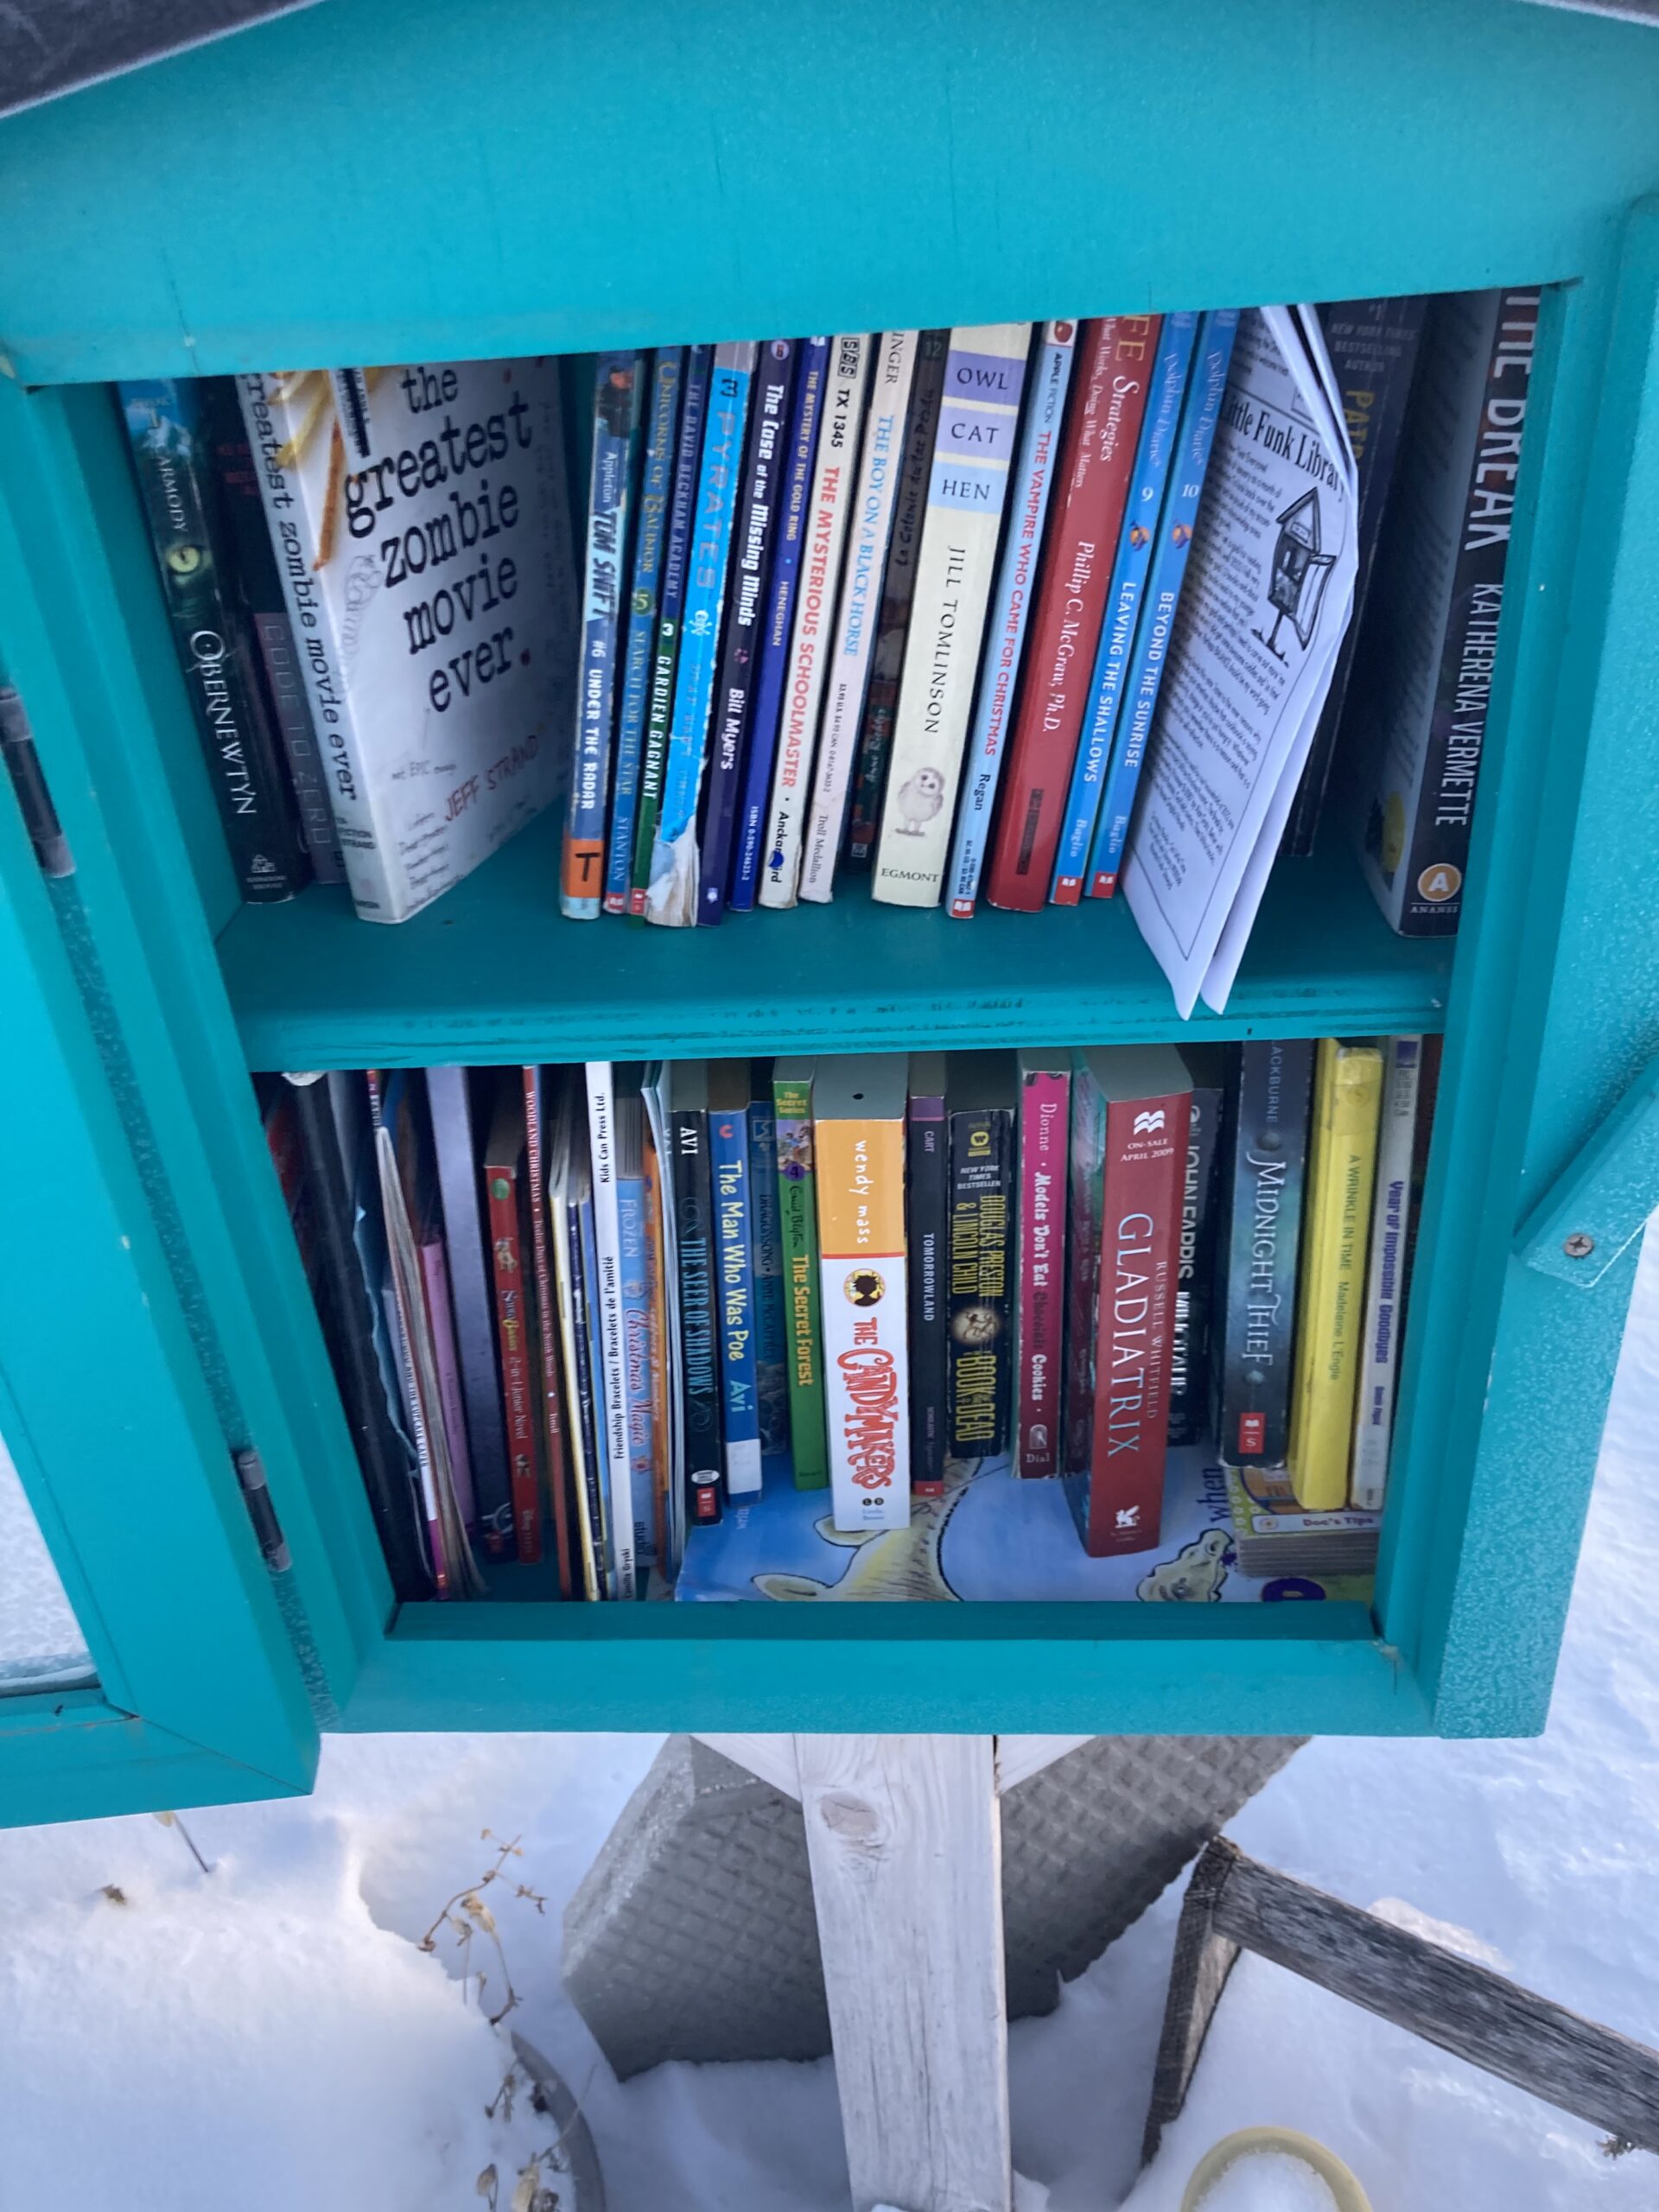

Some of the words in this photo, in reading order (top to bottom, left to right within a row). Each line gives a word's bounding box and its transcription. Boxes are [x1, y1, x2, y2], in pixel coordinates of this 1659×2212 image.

[1331, 323, 1353, 334] NEW
[1333, 340, 1402, 357] BESTSELLING
[807, 371, 819, 390] THE
[957, 367, 1009, 390] OWL
[1050, 353, 1063, 385] APPLE
[1344, 359, 1385, 372] AUTHOR
[400, 366, 459, 414] the
[764, 384, 785, 415] The
[836, 389, 849, 408] TX
[1044, 388, 1058, 423] FICTION
[1086, 385, 1104, 415] Doing
[800, 393, 815, 442] MYSTERY
[831, 415, 847, 448] 1345
[874, 415, 894, 453] THE
[951, 423, 1000, 444] CAT
[1082, 419, 1099, 446] What
[1100, 376, 1140, 462] Strategies
[1254, 409, 1294, 461] Funk
[759, 421, 780, 459] Case
[798, 446, 808, 459] OF
[1035, 430, 1051, 464] THE
[344, 391, 533, 538] greatest
[602, 451, 618, 503] Appleton
[756, 465, 768, 478] of
[794, 463, 807, 481] THE
[821, 467, 840, 504] THE
[869, 457, 889, 493] BOY
[1076, 453, 1091, 488] Matters
[1465, 399, 1527, 551] BREAK
[696, 411, 735, 590] PYRATES
[753, 480, 766, 499] the
[791, 485, 803, 512] GOLD
[864, 496, 880, 524] ON
[943, 480, 991, 501] HEN
[1022, 469, 1045, 539] VAMPIRE
[381, 479, 519, 588] zombie
[594, 511, 618, 551] TOM
[741, 504, 768, 571] Missing
[786, 516, 798, 541] RING
[803, 510, 833, 637] MYSTERIOUS
[853, 543, 874, 600] BLACK
[945, 545, 966, 588] JILL
[1015, 543, 1033, 586] WHO
[1065, 541, 1095, 594] Phillip
[403, 552, 518, 655] movie
[737, 575, 760, 626] Minds
[772, 581, 790, 646] HENEGHAN
[1006, 590, 1023, 633] CAME
[1109, 582, 1136, 657] LEAVING
[842, 601, 867, 658] HORSE
[1147, 592, 1174, 662] BEYOND
[262, 625, 298, 709] CODE
[278, 521, 320, 627] zombie
[305, 638, 340, 723] movie
[329, 734, 358, 801] ever
[924, 600, 958, 734] TOMLINSON
[1000, 639, 1016, 667] FOR
[1453, 584, 1504, 713] KATHERENA
[651, 655, 671, 722] GARDIEN
[1103, 663, 1121, 690] THE
[1140, 667, 1160, 695] THE
[728, 688, 745, 713] Bill
[782, 643, 814, 787] SCHOOLMASTER
[985, 673, 1009, 755] CHRISTMAS
[1042, 693, 1065, 732] Ph.D.
[585, 728, 600, 754] THE
[721, 718, 743, 770] Myers
[1084, 696, 1113, 783] SHALLOWS
[1125, 701, 1151, 768] SUNRISE
[644, 730, 666, 799] GAGNANT
[1435, 721, 1484, 825] VERMETTE
[581, 762, 598, 810] RADAR
[974, 773, 991, 811] Regan
[748, 806, 759, 827] ISBN
[816, 814, 829, 836] Troll
[613, 817, 629, 880] STANTON
[809, 838, 826, 883] Medallion
[881, 868, 939, 883] EGMONT
[525, 1090, 537, 1146] WOODLAND
[597, 1116, 607, 1140] Press
[1039, 1103, 1057, 1151] Dionne
[600, 1142, 608, 1160] Can
[680, 1127, 698, 1154] AVI
[924, 1130, 935, 1151] CART
[530, 1149, 541, 1202] CHRISTMAS
[601, 1164, 610, 1182] Kids
[719, 1160, 742, 1195] The
[850, 1140, 872, 1194] wendy
[1034, 1172, 1052, 1220] Models
[1344, 1166, 1360, 1222] WRINKLE
[1389, 1181, 1405, 1212] Year
[533, 1218, 543, 1243] Twelve
[621, 1198, 639, 1257] FROZEN
[721, 1201, 744, 1238] Man
[760, 1194, 772, 1265] DRAGONSONG
[856, 1205, 868, 1243] mass
[952, 1213, 977, 1259] LINCOLN
[979, 1196, 1006, 1246] DOUGLAS
[1246, 1150, 1287, 1294] MIDNIGHT
[1343, 1226, 1355, 1238] IN
[681, 1237, 707, 1267] THE
[1033, 1225, 1050, 1257] Don't
[1340, 1242, 1353, 1270] TIME
[723, 1245, 745, 1283] Who
[792, 1255, 809, 1281] The
[923, 1232, 935, 1321] TOMORROWLAND
[952, 1263, 977, 1294] CHILD
[979, 1250, 1004, 1297] PRESTON
[1033, 1263, 1049, 1286] Eat
[1380, 1231, 1399, 1300] Impossible
[607, 1298, 614, 1309] de
[683, 1271, 709, 1307] SEER
[726, 1288, 747, 1325] Was
[1152, 1261, 1168, 1329] RUSSELL
[1334, 1281, 1350, 1337] Madeleine
[685, 1311, 710, 1325] OF
[794, 1287, 811, 1335] Secret
[854, 1316, 878, 1344] THE
[1243, 1294, 1281, 1365] THIEF
[607, 1313, 619, 1357] Bracelets
[626, 1307, 652, 1391] Christmas
[728, 1331, 749, 1361] Poe
[1107, 1212, 1154, 1458] GLADIATRIX
[1375, 1305, 1393, 1363] Goodbyes
[685, 1330, 713, 1395] SHADOWS
[798, 1339, 815, 1386] Forest
[957, 1356, 996, 1398] BOOK
[1032, 1355, 1047, 1400] Cookies
[1147, 1336, 1162, 1419] WHITFIELD
[611, 1367, 621, 1409] Bracelets
[729, 1380, 753, 1412] Avi
[515, 1414, 528, 1439] Novel
[611, 1413, 626, 1459] Friendship
[629, 1398, 653, 1446] Magic
[956, 1403, 995, 1441] DEAD
[1343, 1516, 1374, 1525] Tips
